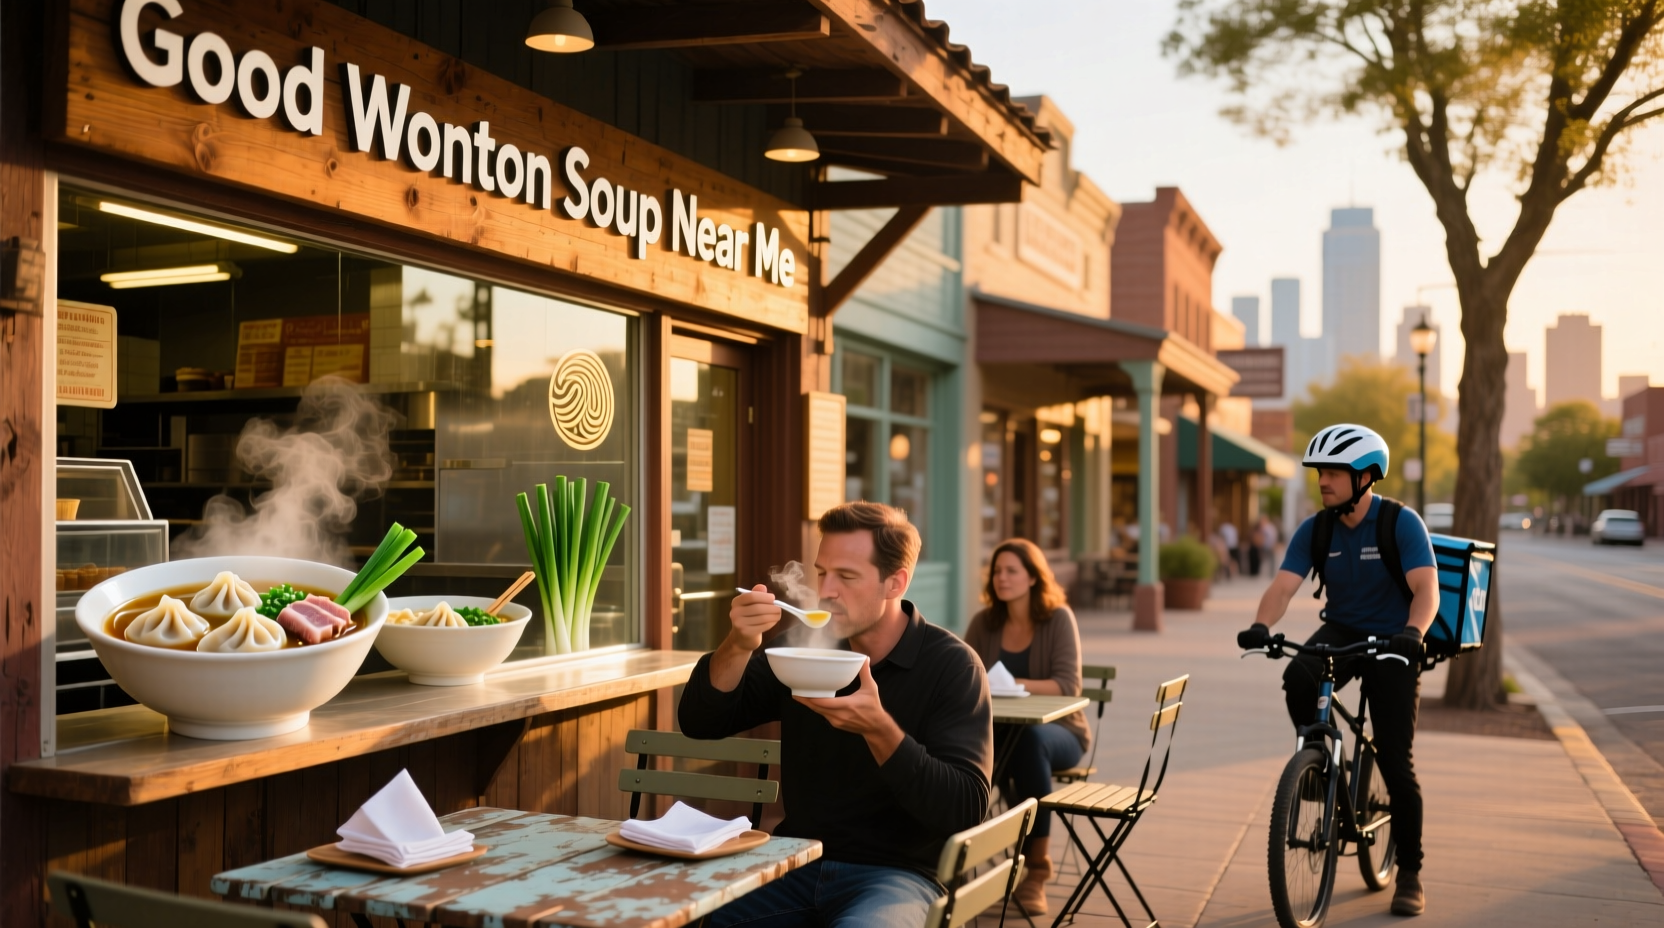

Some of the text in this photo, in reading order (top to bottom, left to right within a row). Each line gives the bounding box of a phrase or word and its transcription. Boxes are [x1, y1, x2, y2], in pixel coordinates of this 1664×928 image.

[120, 0, 796, 288] Good Wonton Soup Near Me
